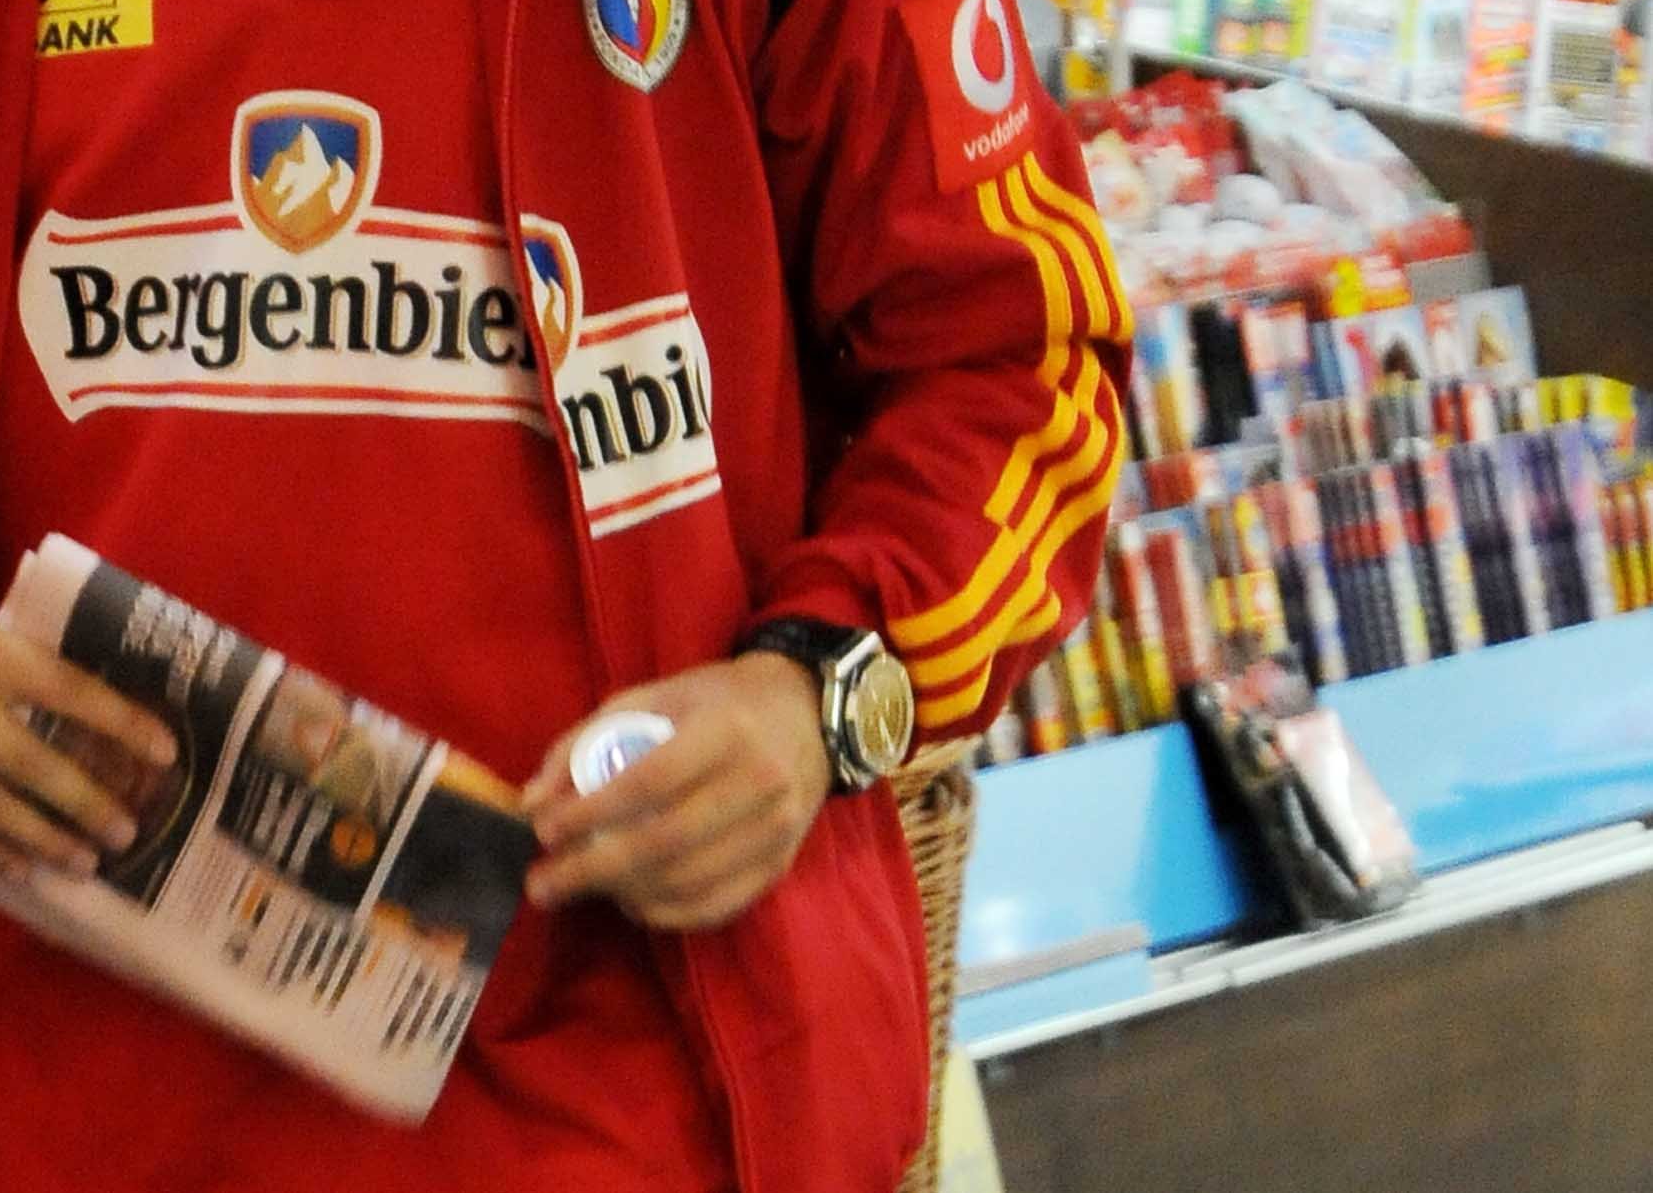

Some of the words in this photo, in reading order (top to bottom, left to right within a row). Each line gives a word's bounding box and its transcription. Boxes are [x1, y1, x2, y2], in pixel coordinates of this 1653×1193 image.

[37, 15, 121, 53] ANK
[49, 260, 538, 371] Bergenbie
[561, 344, 709, 473] nbi
